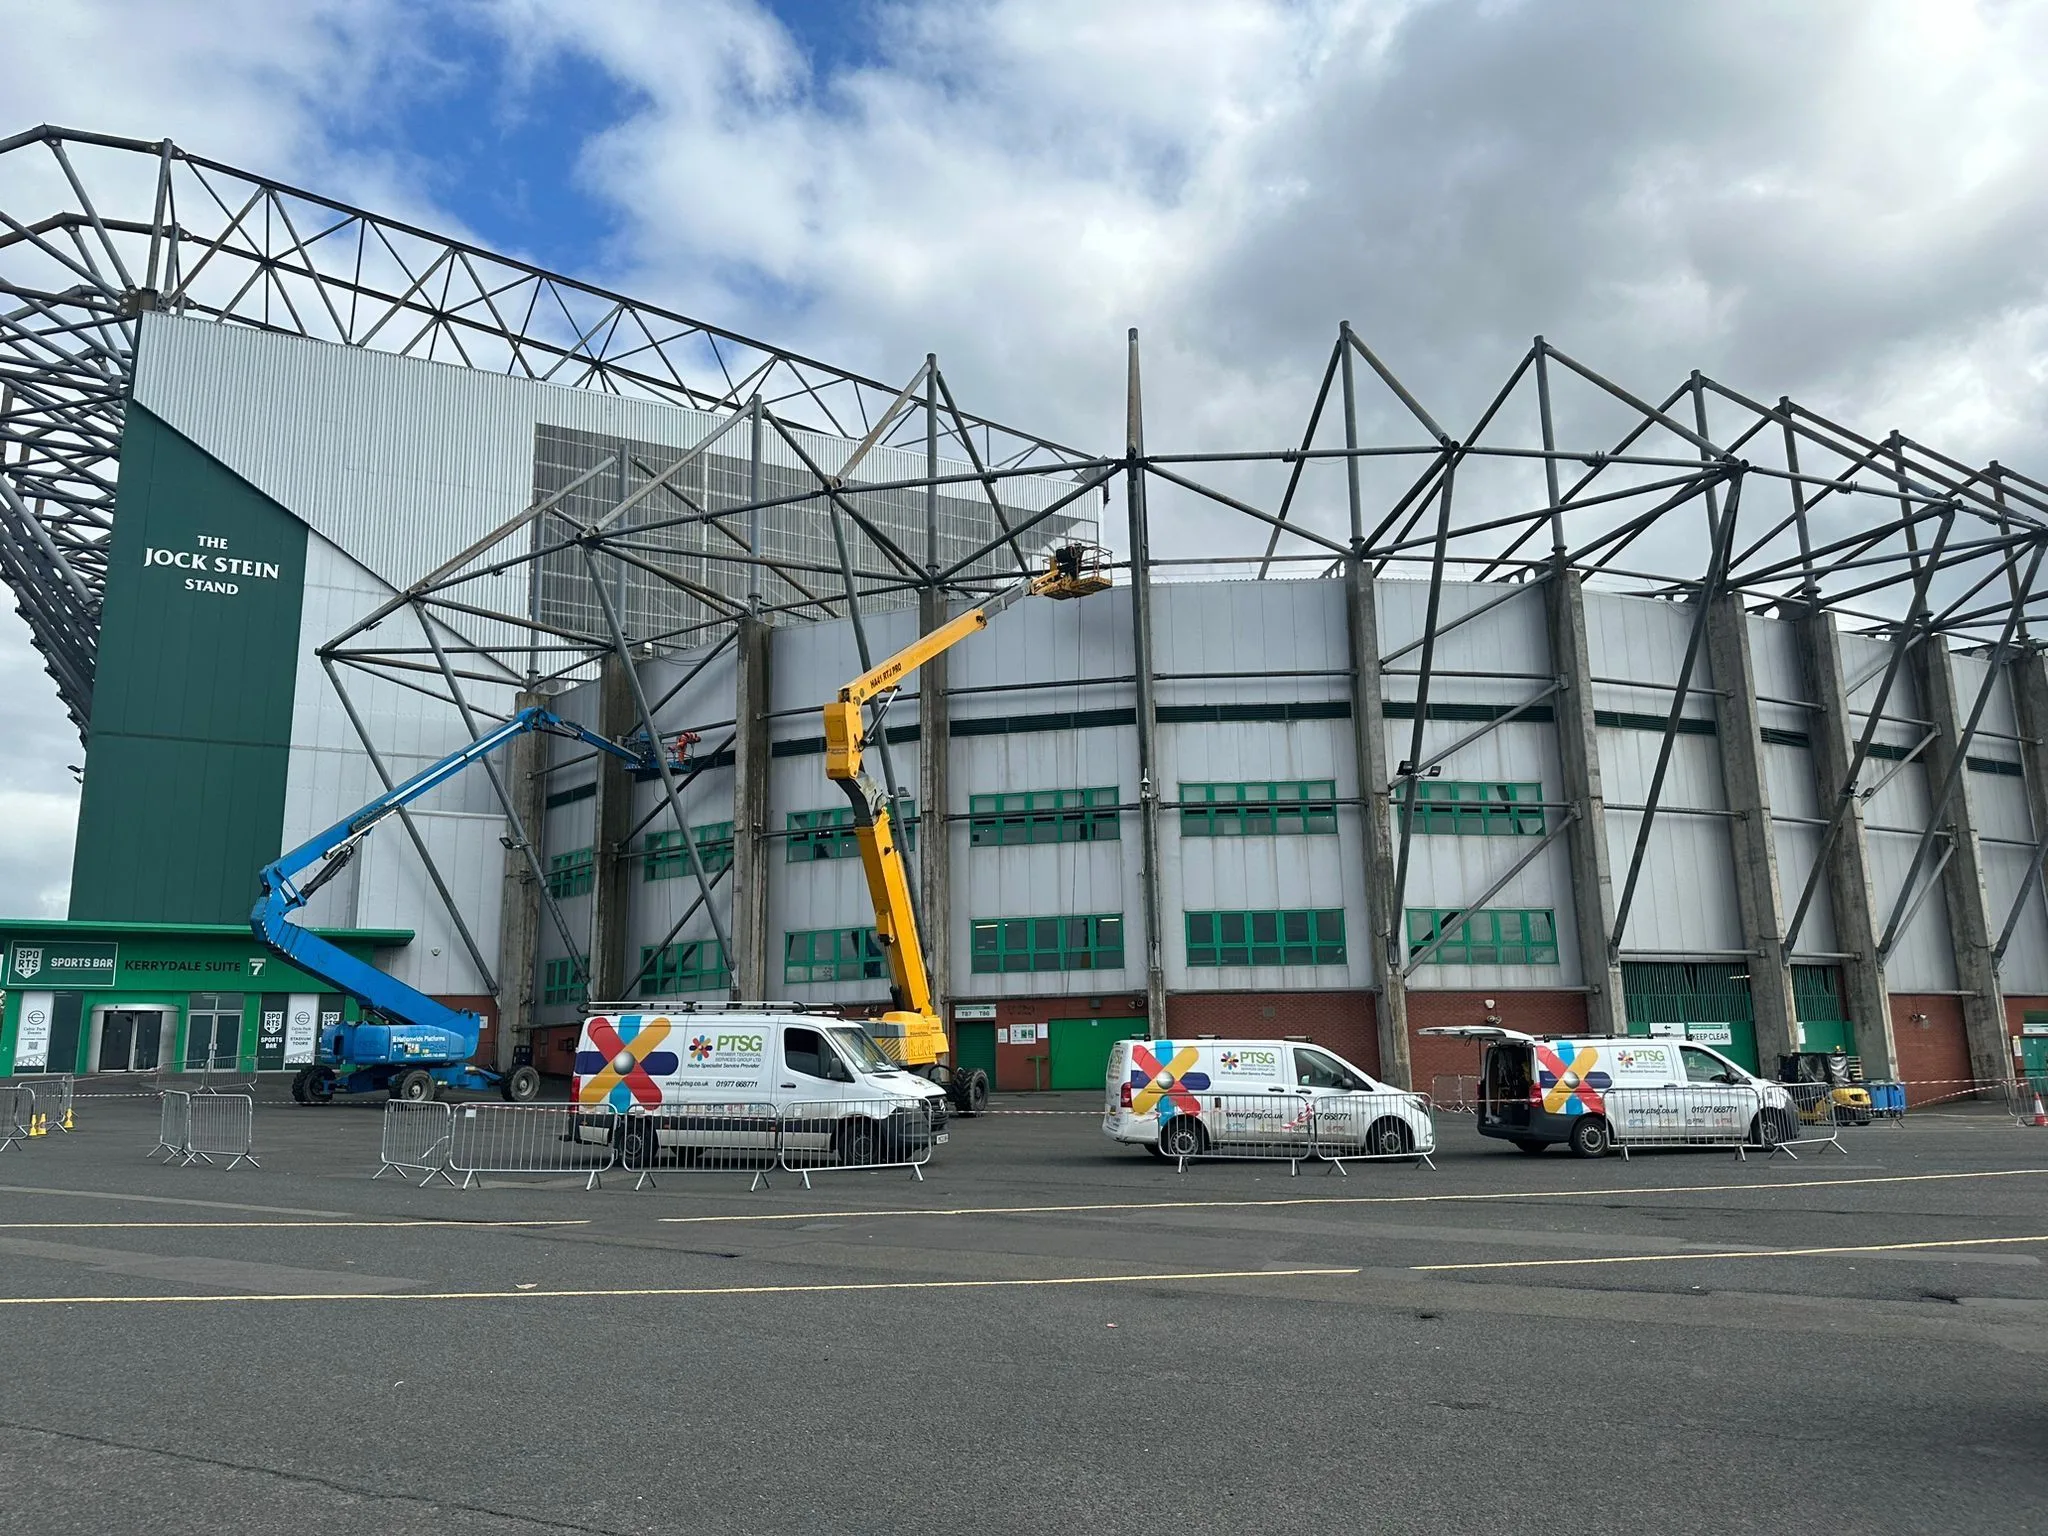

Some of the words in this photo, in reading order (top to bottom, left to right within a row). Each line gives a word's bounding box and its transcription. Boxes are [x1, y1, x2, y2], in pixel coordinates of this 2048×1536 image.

[197, 535, 228, 550] THE
[144, 547, 208, 571] JOCK
[213, 557, 280, 579] STEIN
[184, 578, 239, 595] STAND
[892, 662, 902, 675] PRO
[19, 950, 40, 959] SPO
[18, 960, 39, 969] RTS
[50, 957, 91, 967] SPORTS
[92, 958, 113, 968] BAR
[124, 960, 201, 971] KERRYDALE
[205, 961, 240, 972] SUITE
[250, 962, 263, 976] 7
[1709, 1033, 1729, 1041] CLEAR
[716, 1035, 762, 1051] PTSG
[1240, 1052, 1275, 1064] PTSG
[1634, 1050, 1666, 1061] PTSG
[715, 1080, 736, 1088] 01977
[1691, 1105, 1712, 1113] 01977
[1713, 1105, 1737, 1113] 668771
[1226, 1112, 1283, 1120] www.ptsg.co.uk
